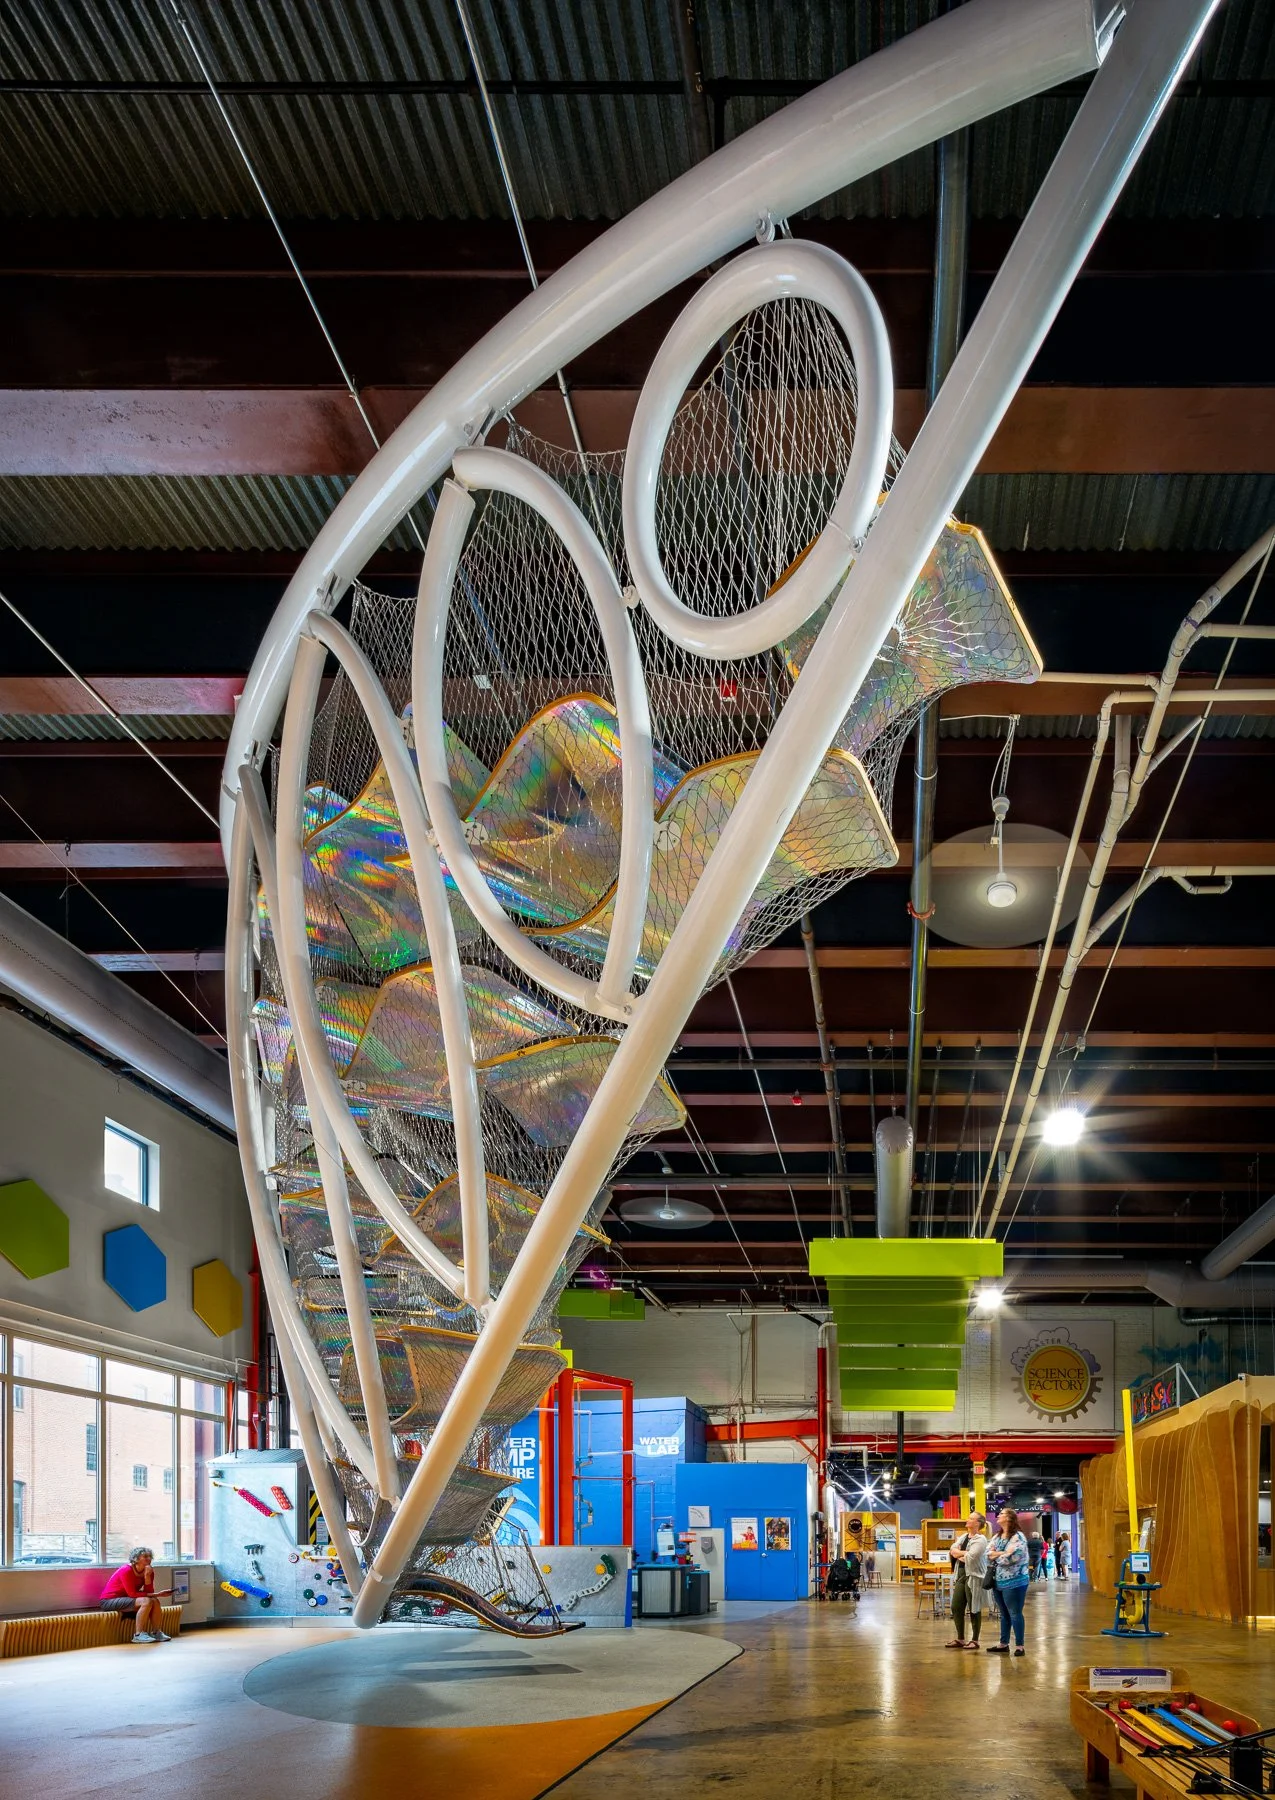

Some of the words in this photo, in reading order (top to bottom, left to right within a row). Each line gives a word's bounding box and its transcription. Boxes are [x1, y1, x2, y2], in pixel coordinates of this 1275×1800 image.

[1028, 1368, 1085, 1379] SCIENCE
[1028, 1380, 1085, 1391] FACTORY
[639, 1436, 680, 1445] WATER
[647, 1445, 680, 1455] LAB
